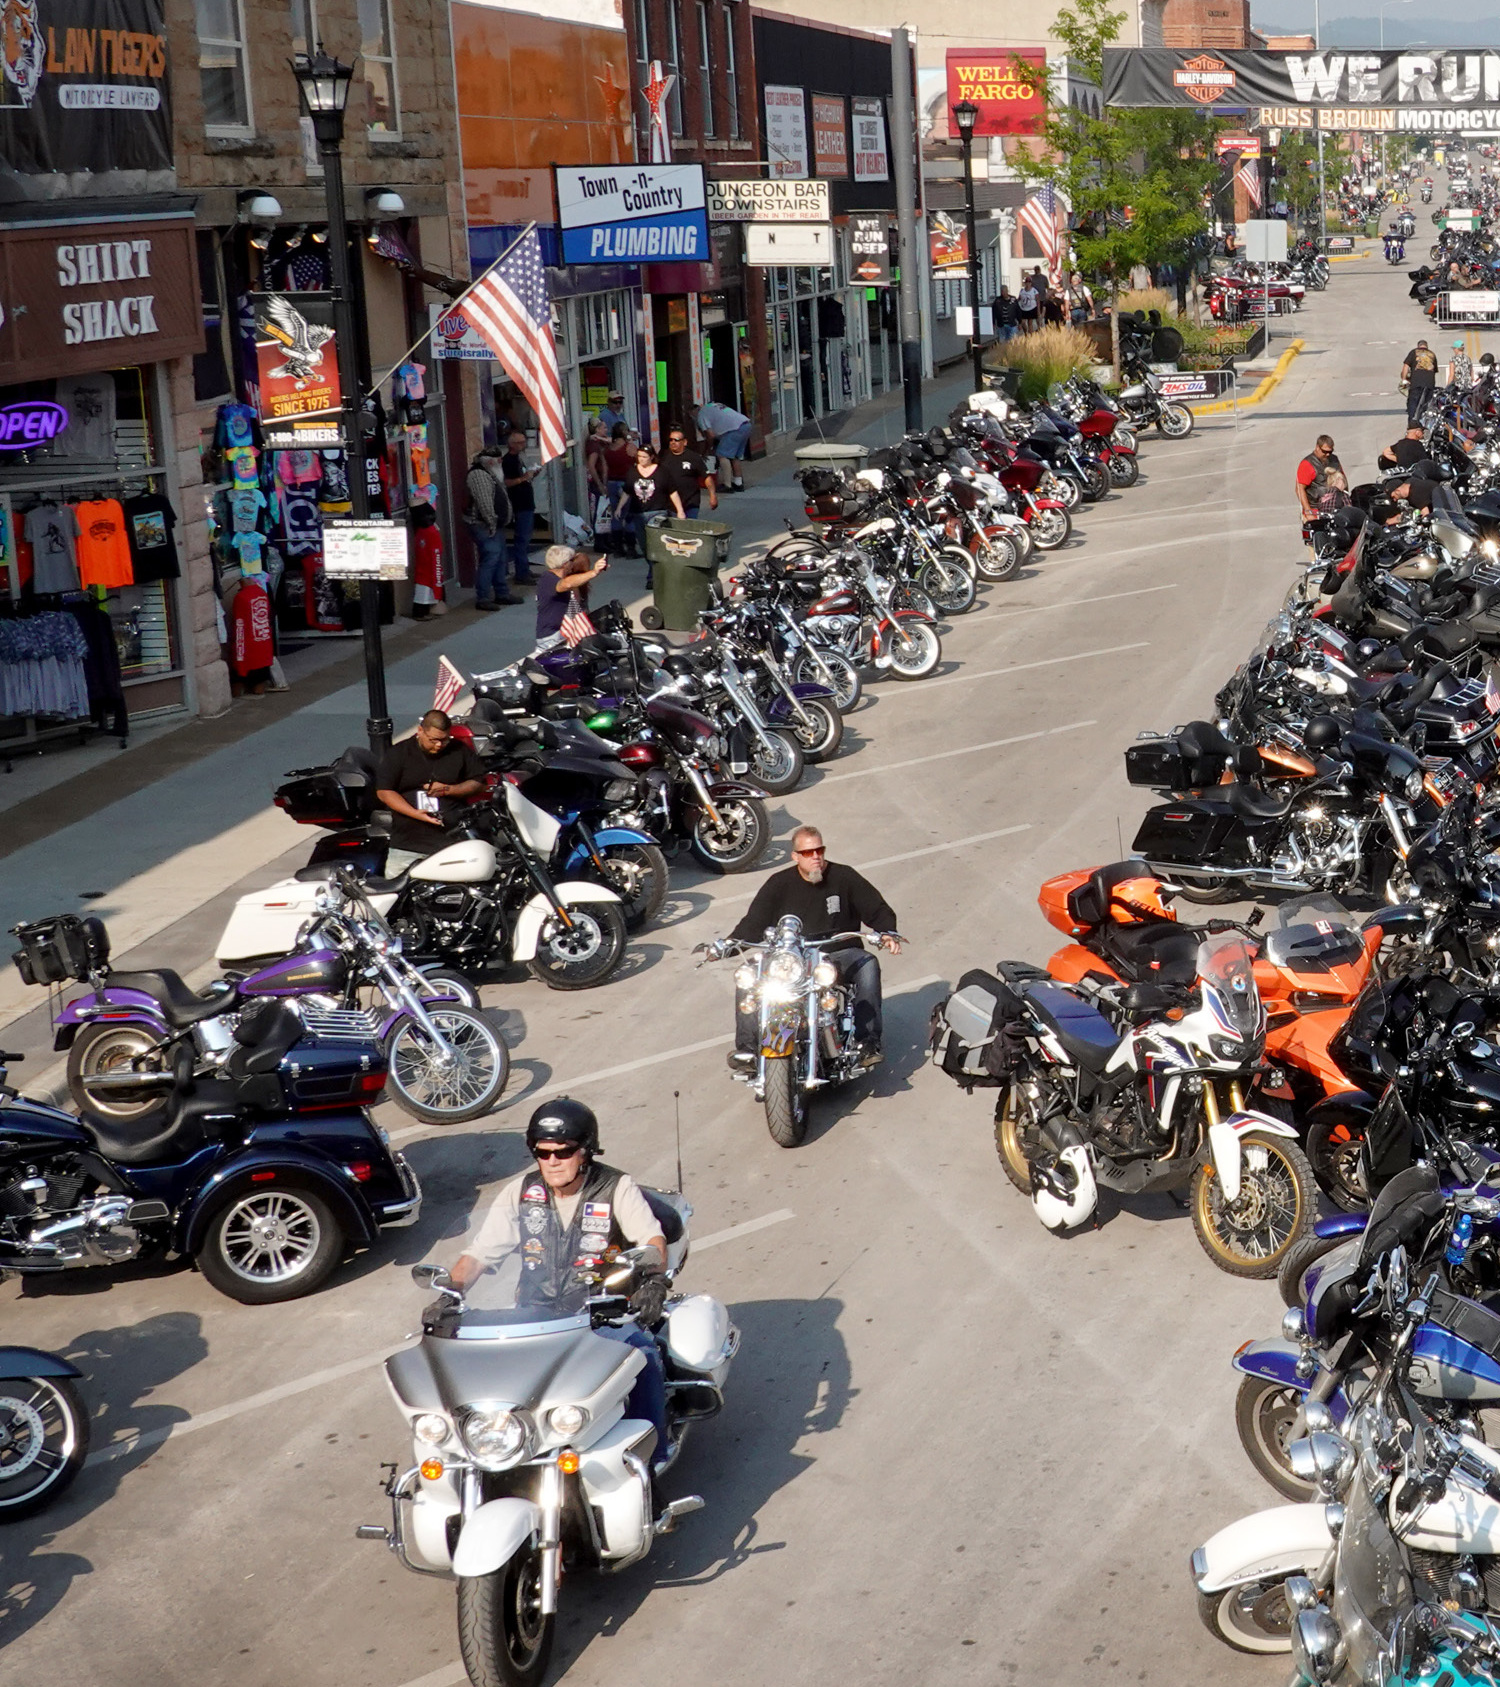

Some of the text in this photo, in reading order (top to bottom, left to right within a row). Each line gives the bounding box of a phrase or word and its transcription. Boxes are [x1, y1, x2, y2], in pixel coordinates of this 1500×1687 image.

[101, 29, 165, 77] TIGERS
[1189, 60, 1223, 70] MOTOR
[955, 66, 1032, 81] WELL
[1176, 73, 1233, 84] HARLEY-DAVIDSON
[1285, 56, 1381, 101] WE
[959, 84, 1034, 100] FARGO
[1190, 87, 1221, 99] CYCLES
[1261, 107, 1313, 128] RUSS
[1318, 109, 1395, 130] BROWN
[816, 130, 845, 155] LEATHER
[578, 176, 619, 198] Town
[706, 183, 827, 197] DUNGEON BAR
[623, 186, 682, 212] Country
[713, 199, 820, 211] DOWNSTAIRS
[857, 219, 879, 231] WE
[590, 225, 698, 257] PLUMBING
[768, 233, 820, 244] N T
[854, 231, 883, 242] RUN
[852, 243, 887, 254] DEEP
[57, 240, 151, 286] SHIRT
[63, 295, 160, 344] SHACK
[1161, 381, 1207, 393] AMSOIL
[273, 396, 329, 416] SINCE 1975
[270, 429, 338, 442] 1-800-4BIKERS
[333, 519, 394, 527] OPEN CONTAINER
